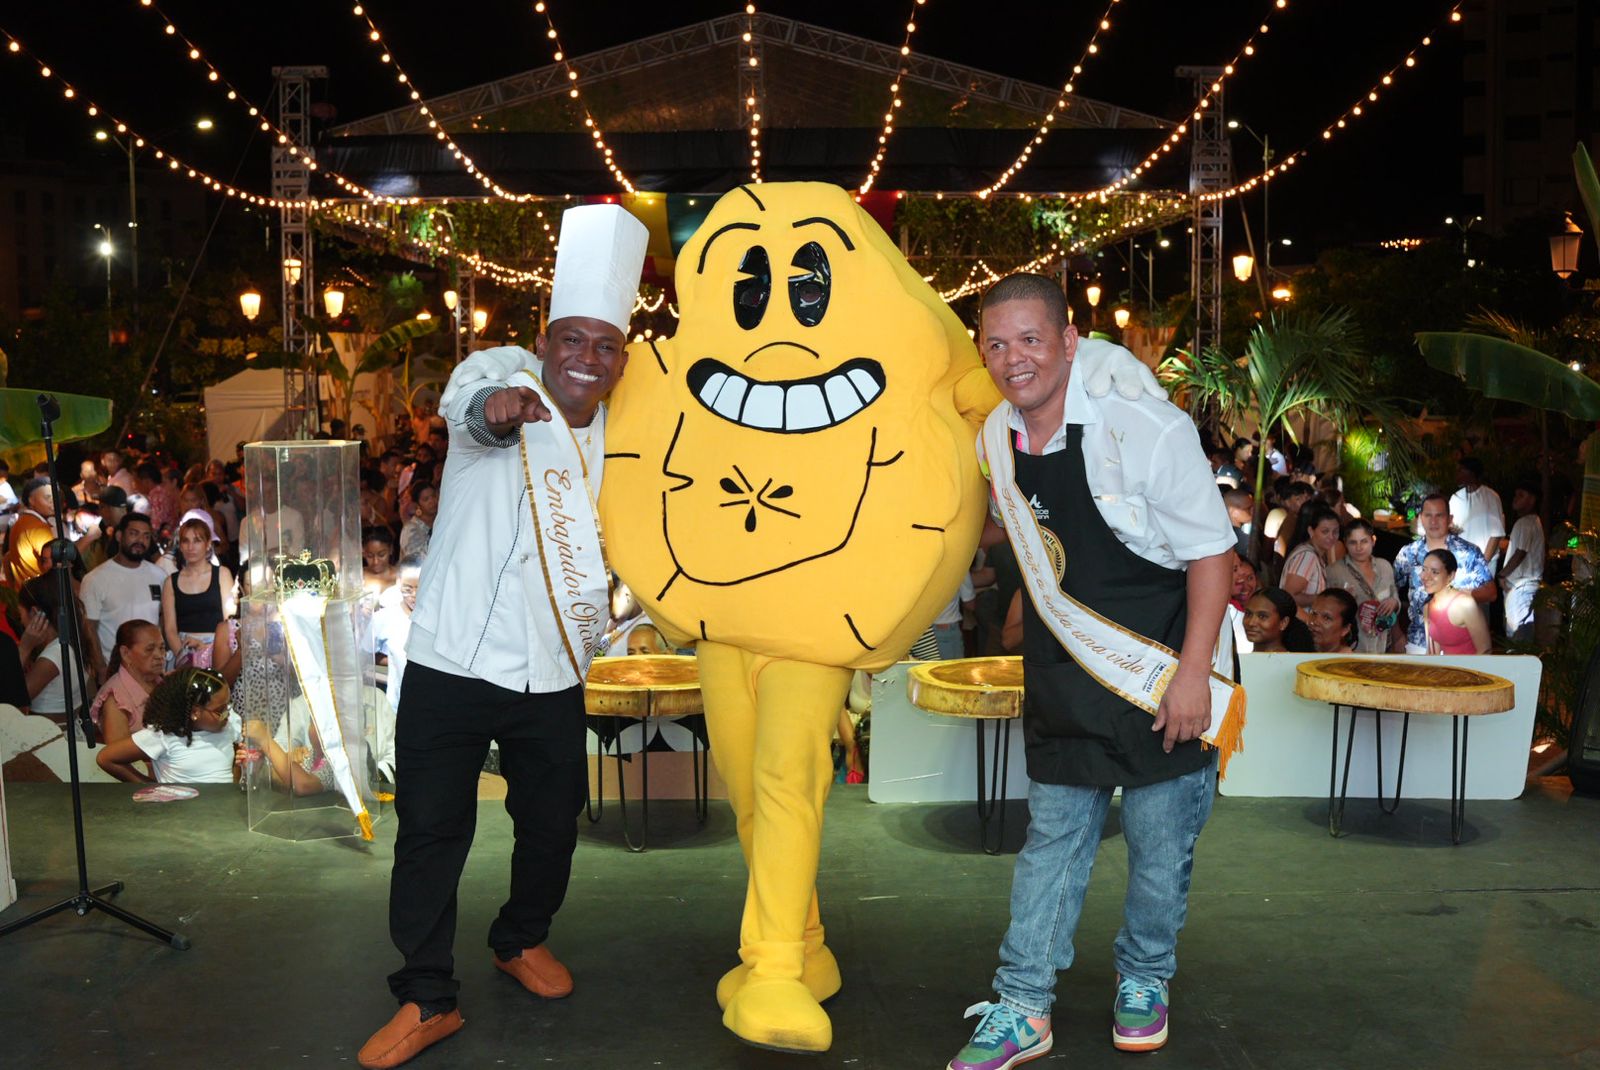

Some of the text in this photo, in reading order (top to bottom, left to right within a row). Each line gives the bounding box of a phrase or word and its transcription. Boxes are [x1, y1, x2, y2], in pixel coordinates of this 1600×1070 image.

[543, 468, 588, 598] Embajador
[1002, 488, 1145, 675] Homenaje a toda una vida
